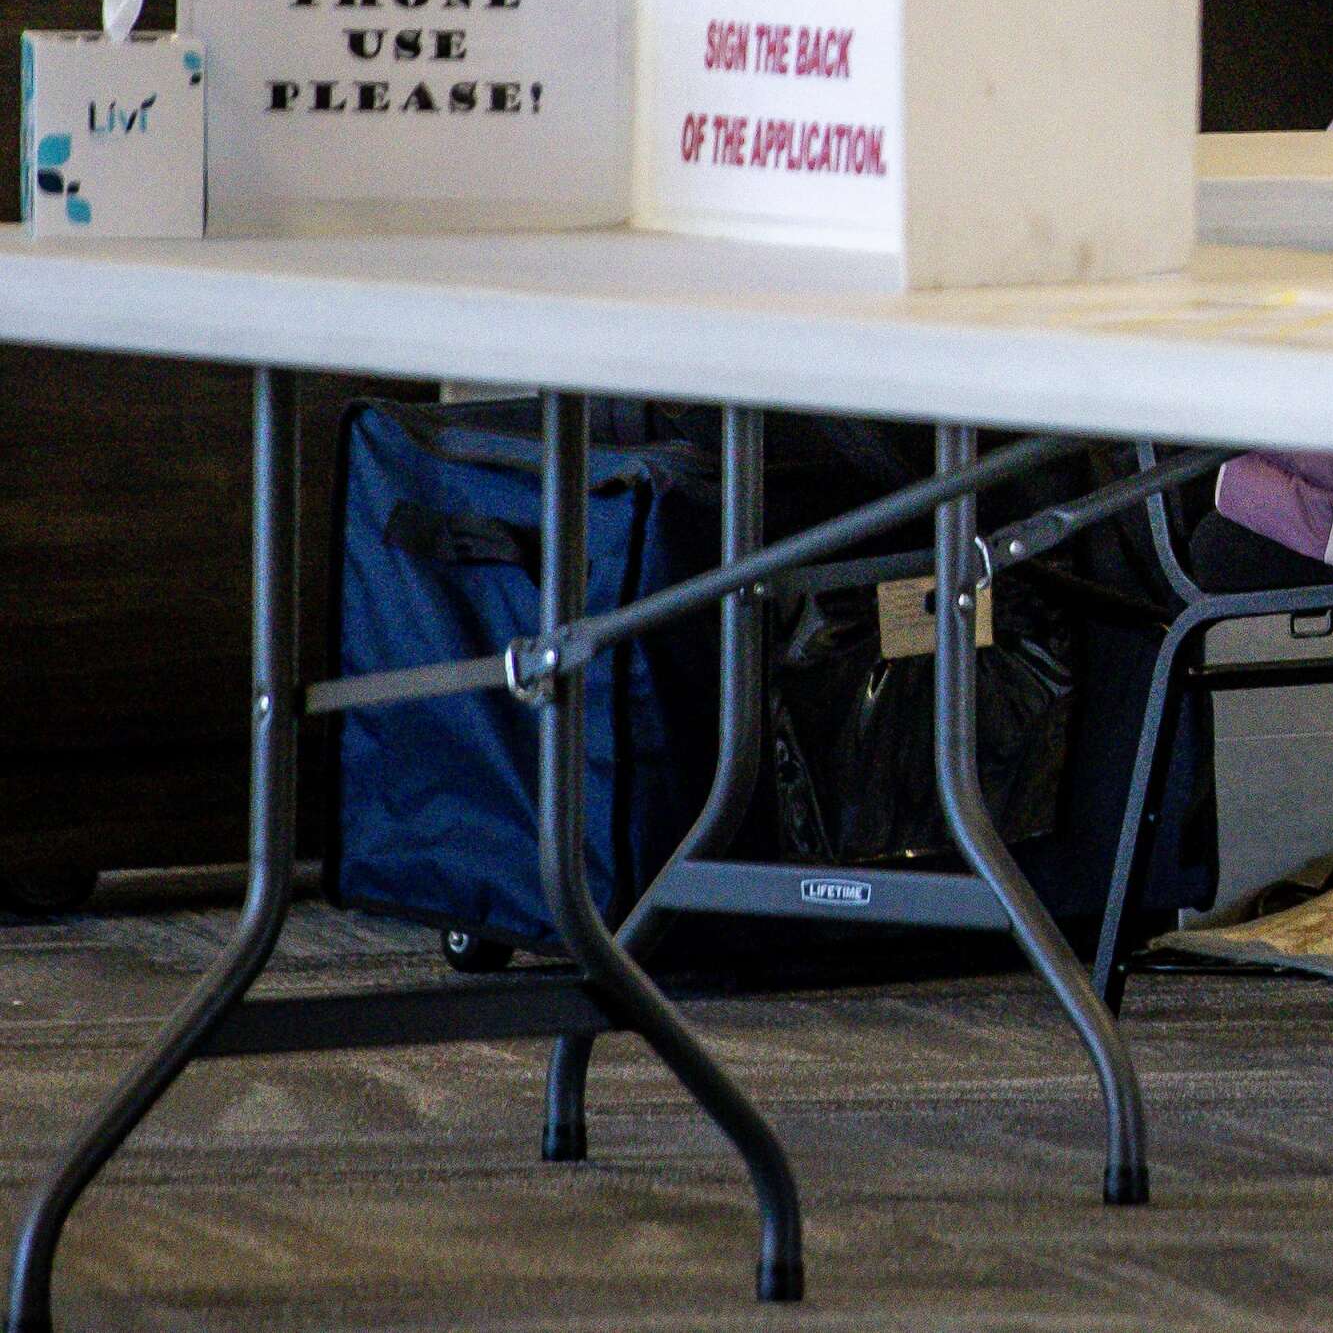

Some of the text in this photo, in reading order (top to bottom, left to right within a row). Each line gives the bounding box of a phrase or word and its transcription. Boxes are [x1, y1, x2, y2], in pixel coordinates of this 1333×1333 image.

[341, 27, 468, 61] USE
[704, 19, 854, 79] SIGN THE BACK
[265, 79, 545, 115] PLEASE!
[680, 112, 887, 177] OF THE APPLICATION.
[809, 883, 864, 900] LIFETIME
